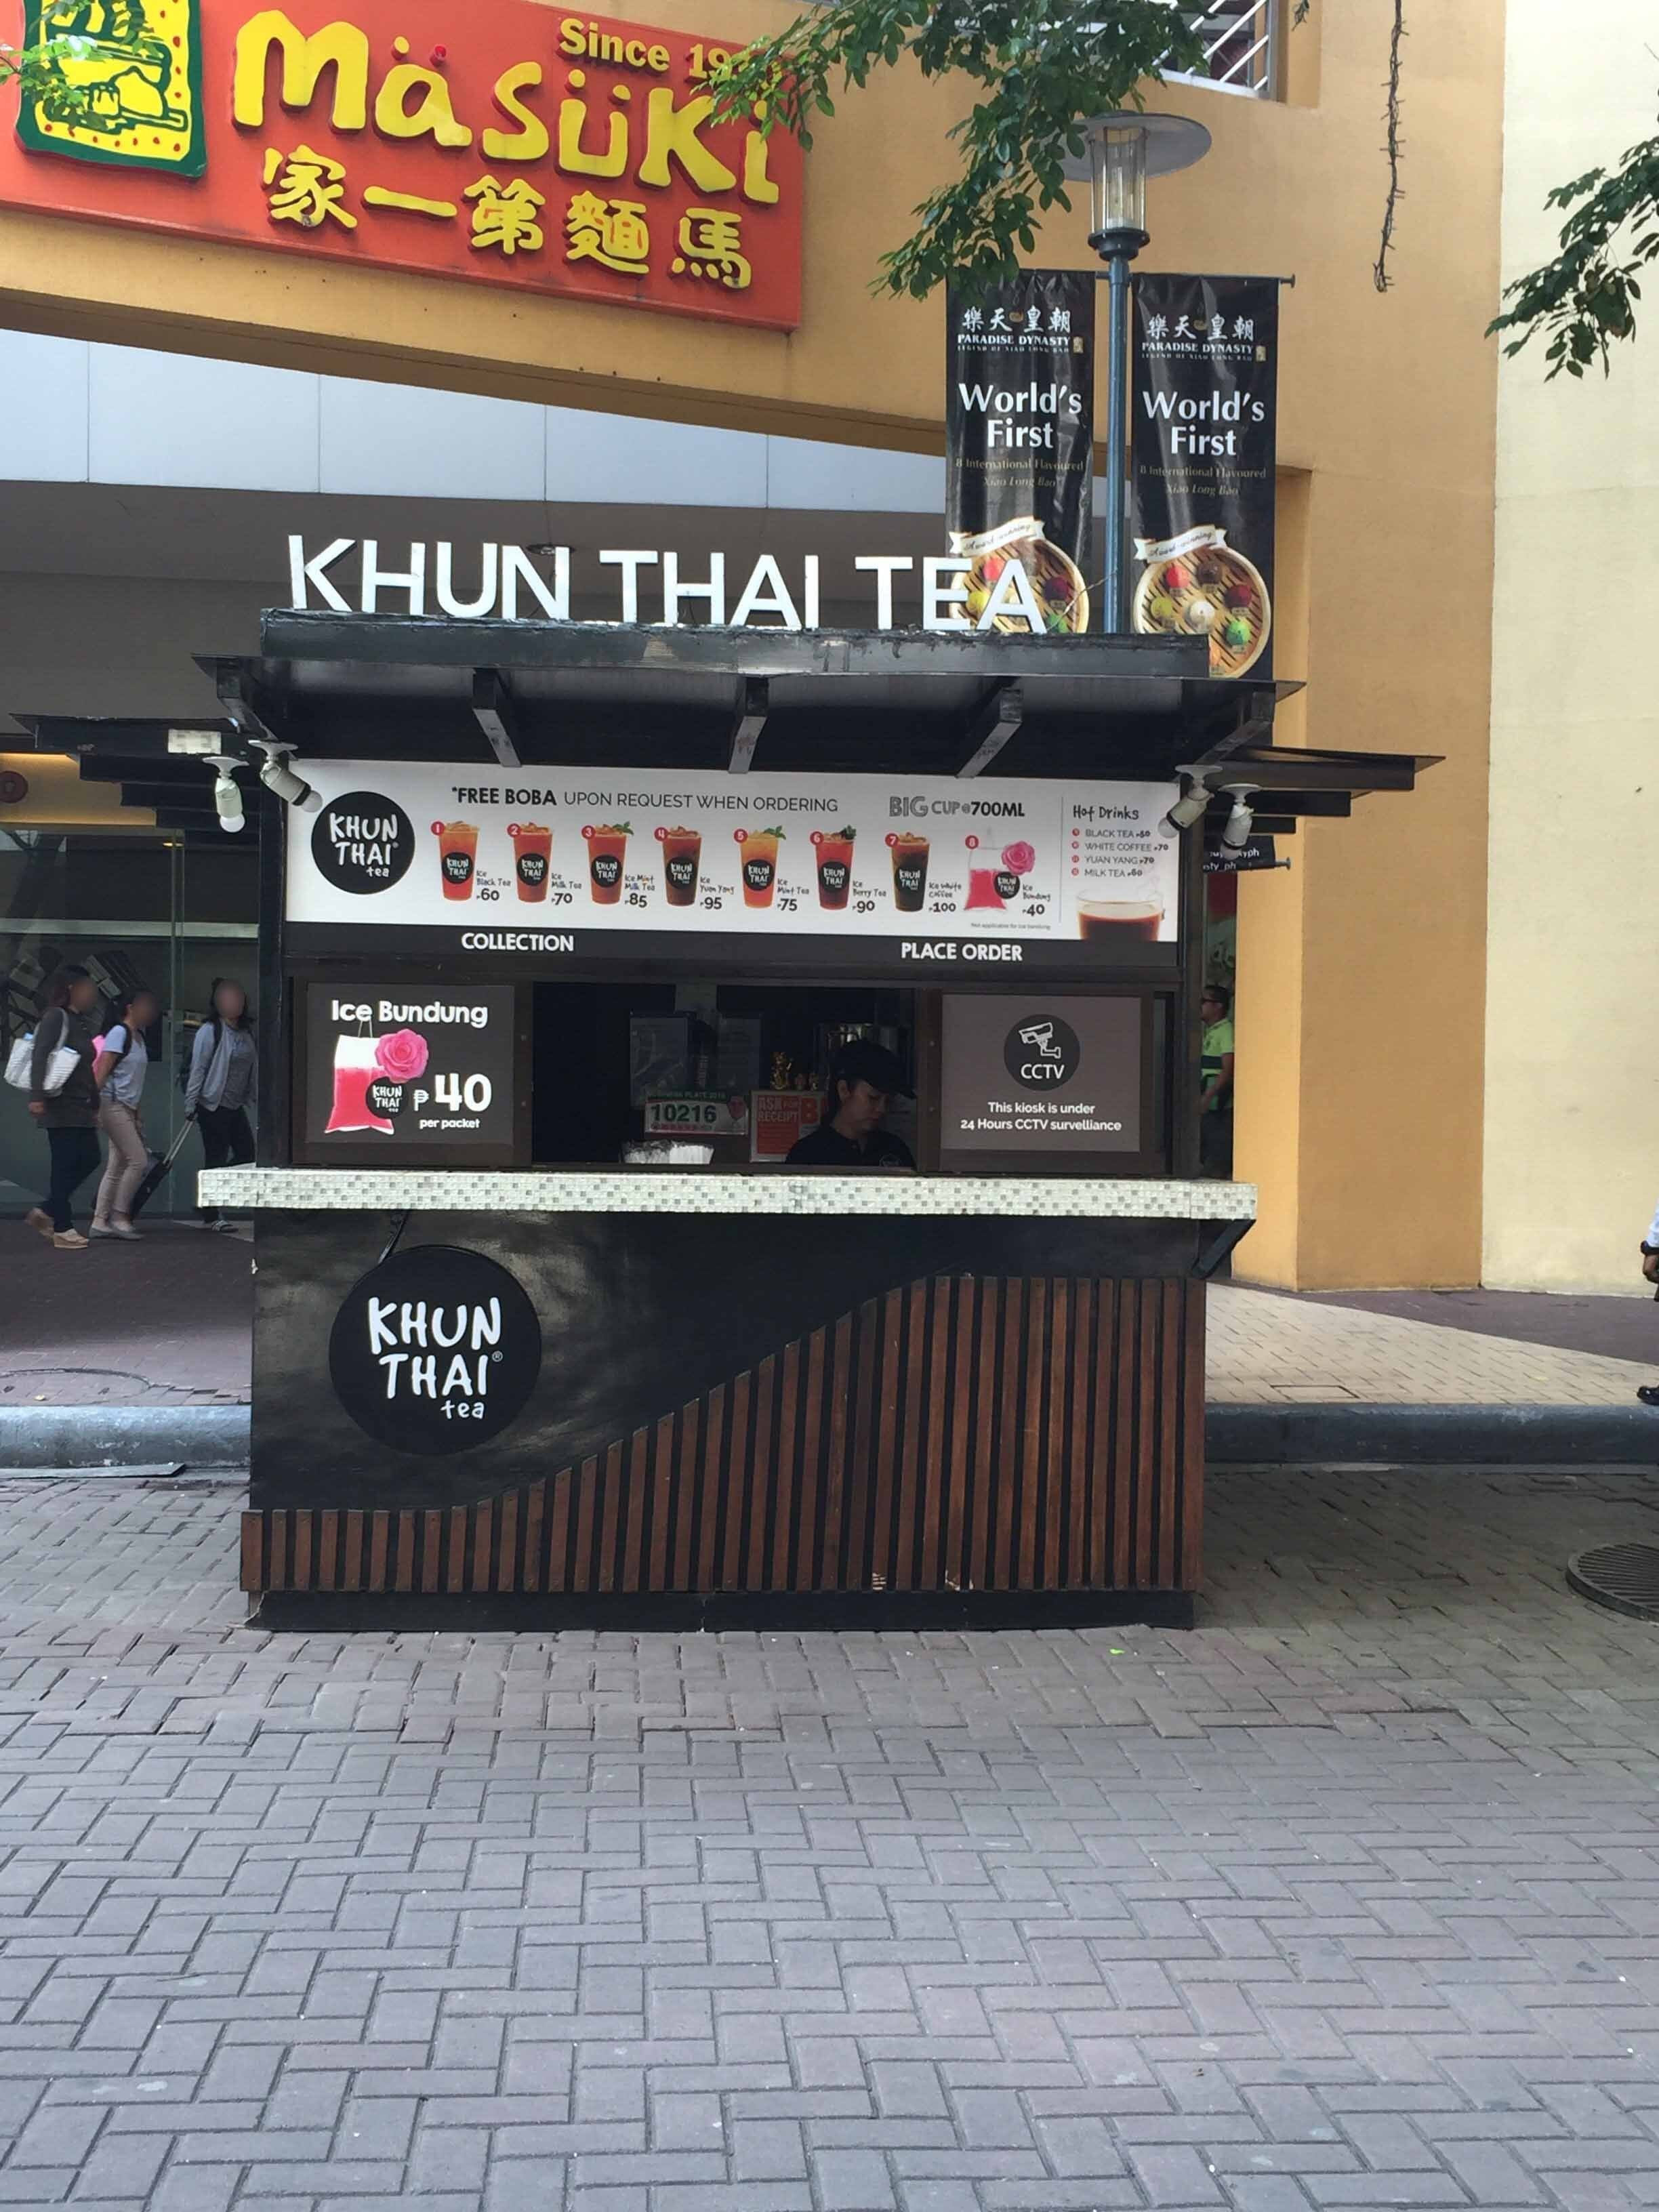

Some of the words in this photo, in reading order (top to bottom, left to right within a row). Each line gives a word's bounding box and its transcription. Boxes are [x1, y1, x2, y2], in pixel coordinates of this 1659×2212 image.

[559, 18, 670, 71] Since
[958, 334, 1015, 344] PARADISE
[1019, 336, 1071, 346] DYNASTY
[1142, 342, 1198, 352] PARADISE
[1202, 344, 1253, 354] DYNASTY
[958, 382, 1082, 415] World's
[1143, 390, 1265, 422] World's
[987, 417, 1054, 449] First
[1171, 424, 1237, 456] First
[966, 458, 1031, 470] International
[1149, 466, 1214, 477] International
[289, 535, 571, 621] KHUN
[600, 550, 819, 631] THAI
[855, 556, 1048, 635] TEA
[505, 788, 557, 806] BOBA
[564, 792, 611, 806] UPON
[617, 793, 693, 808] REQUEST
[697, 795, 748, 810] WHEN
[753, 796, 838, 812] ORDERING
[889, 796, 928, 817] BIG
[1073, 804, 1095, 822] Hot
[1099, 805, 1139, 820] Drinks
[330, 813, 398, 843] KHUN
[1086, 829, 1115, 838] BLACK
[1118, 830, 1134, 838] TEA
[1085, 842, 1115, 851] WHITE
[1118, 843, 1152, 852] COFFEE
[1084, 856, 1110, 864] YUAN
[1113, 856, 1139, 865] YANG
[366, 867, 390, 877] tea
[1085, 868, 1106, 877] MILK
[1108, 869, 1126, 878] TEA
[498, 878, 511, 886] Tea
[569, 881, 582, 889] Tea
[642, 883, 655, 891] Tea
[928, 882, 940, 890] Ice
[797, 886, 810, 895] Tea
[874, 889, 886, 897] Tea
[461, 933, 575, 951] COLLECTION
[901, 942, 957, 960] PLACE
[962, 944, 1023, 962] ORDER
[331, 1000, 373, 1021] Ice
[378, 1000, 488, 1029] Bundung
[1020, 1063, 1065, 1079] CCTV
[372, 1084, 403, 1098] KHUN
[651, 1103, 717, 1123] 10216
[987, 1101, 1012, 1113] This
[1015, 1102, 1046, 1113] kiosk
[1048, 1103, 1057, 1113] is
[1060, 1103, 1096, 1113] under
[419, 1120, 439, 1130] per
[441, 1118, 480, 1130] packet
[960, 1120, 975, 1130] 24
[977, 1118, 1013, 1130] Hours
[1015, 1118, 1048, 1130] CCTV
[368, 1296, 501, 1355] KHUN
[441, 1399, 485, 1420] tea
